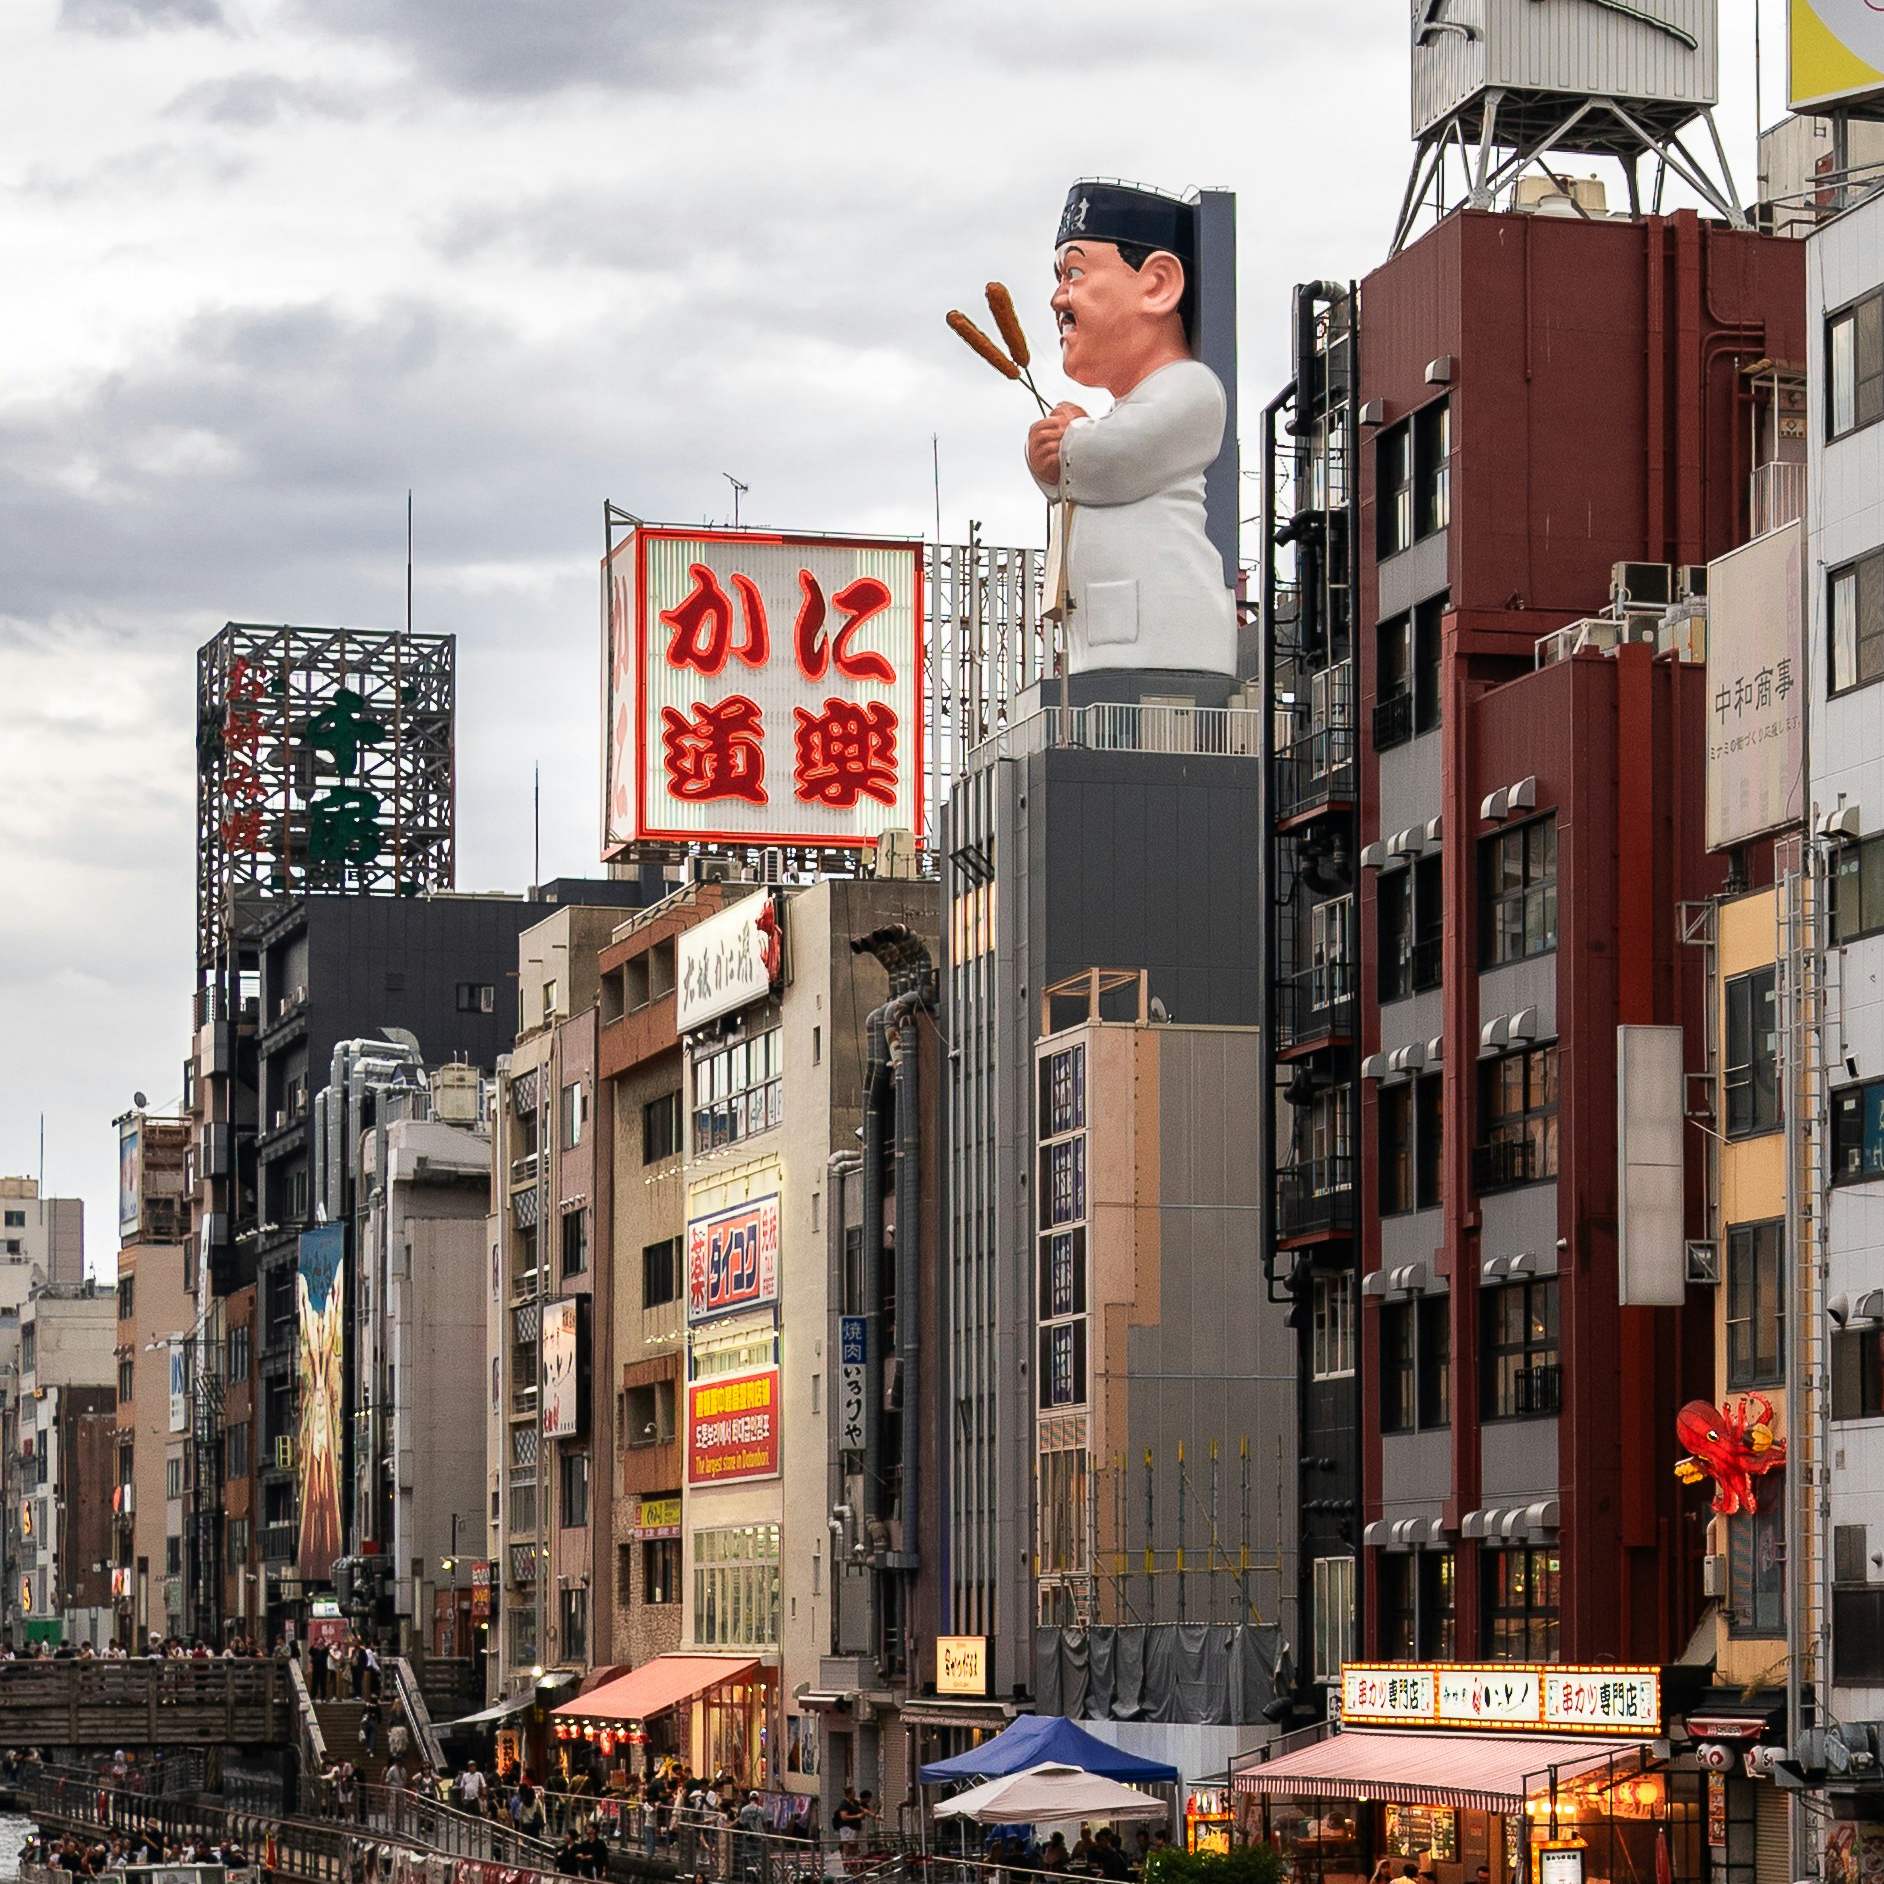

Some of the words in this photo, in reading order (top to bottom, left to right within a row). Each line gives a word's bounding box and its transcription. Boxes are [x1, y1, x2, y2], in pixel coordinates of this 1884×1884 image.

[658, 562, 897, 686] かに
[1715, 657, 1795, 726] 中和商事
[306, 689, 387, 865] 千房
[661, 694, 899, 810] 道楽
[710, 1219, 759, 1302] ダイコク
[843, 1321, 863, 1362] 焼肉
[843, 1366, 863, 1447] いろりや
[1358, 1677, 1420, 1711] 串カツ専門店
[1562, 1680, 1638, 1718] 串カツ専門店
